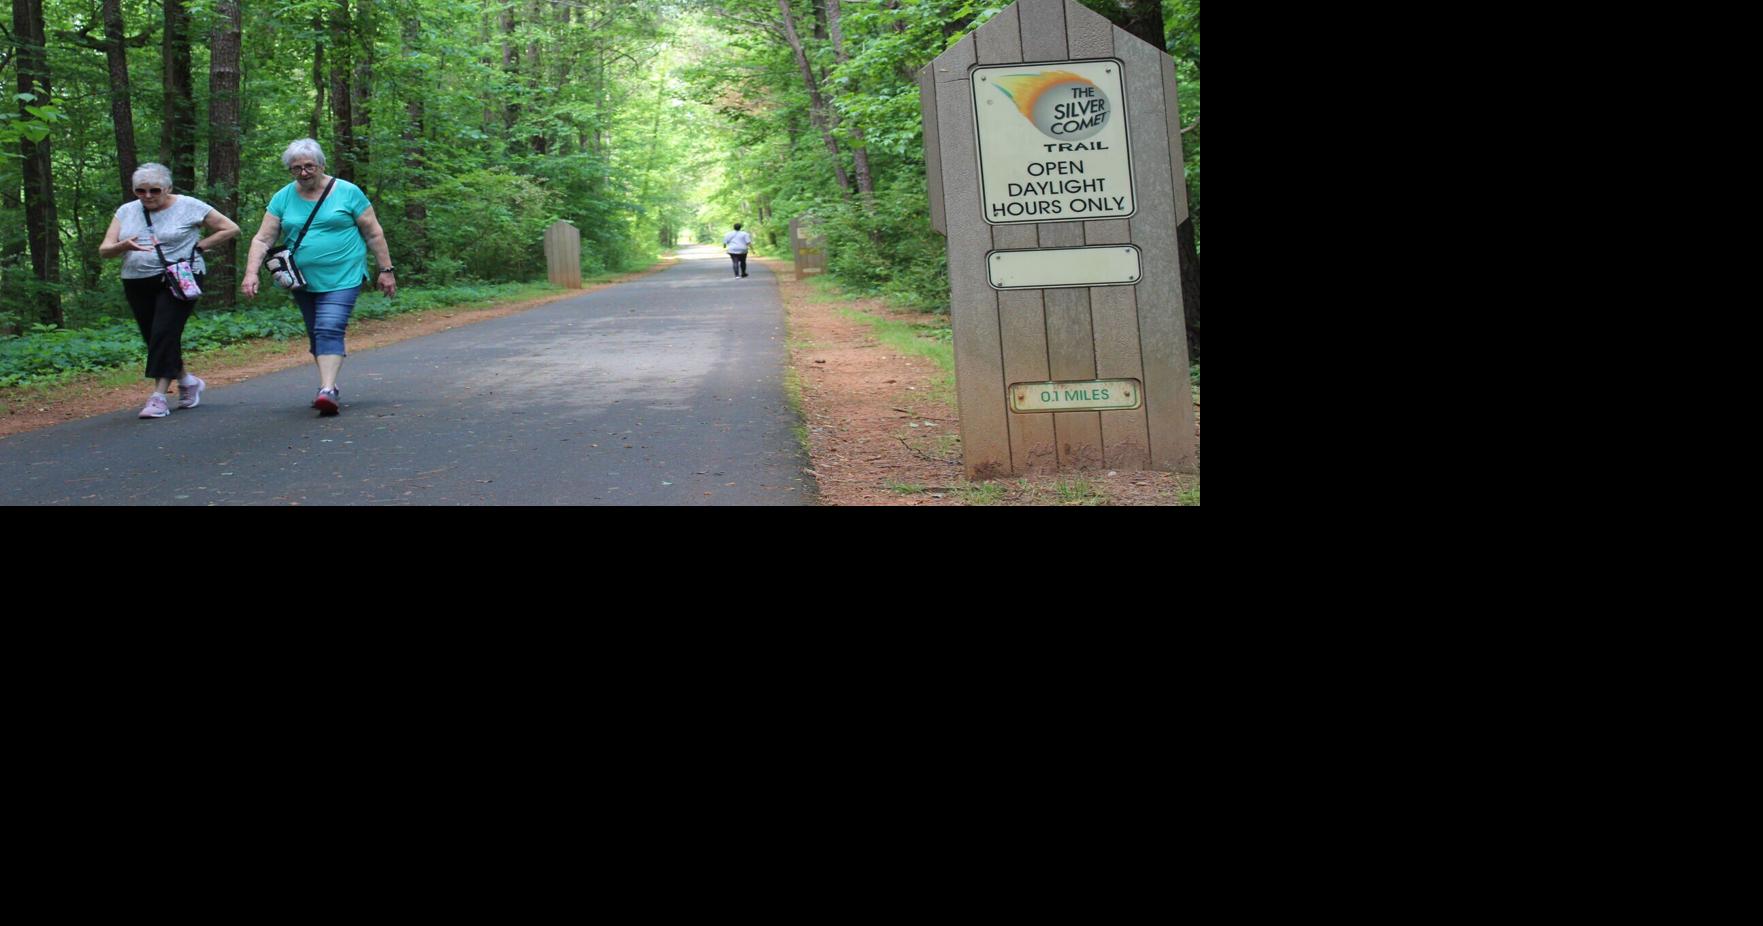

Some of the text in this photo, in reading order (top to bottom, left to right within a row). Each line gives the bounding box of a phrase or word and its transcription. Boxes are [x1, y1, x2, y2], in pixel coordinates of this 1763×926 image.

[1071, 87, 1095, 99] THE
[1054, 99, 1105, 120] SILVER
[1050, 112, 1107, 135] COMET
[1043, 141, 1109, 153] TRAIL
[1027, 160, 1084, 177] OPEN
[1008, 178, 1106, 197] DAYLIGHT
[992, 196, 1125, 217] HOURS ONLY
[1065, 389, 1110, 401] MILES
